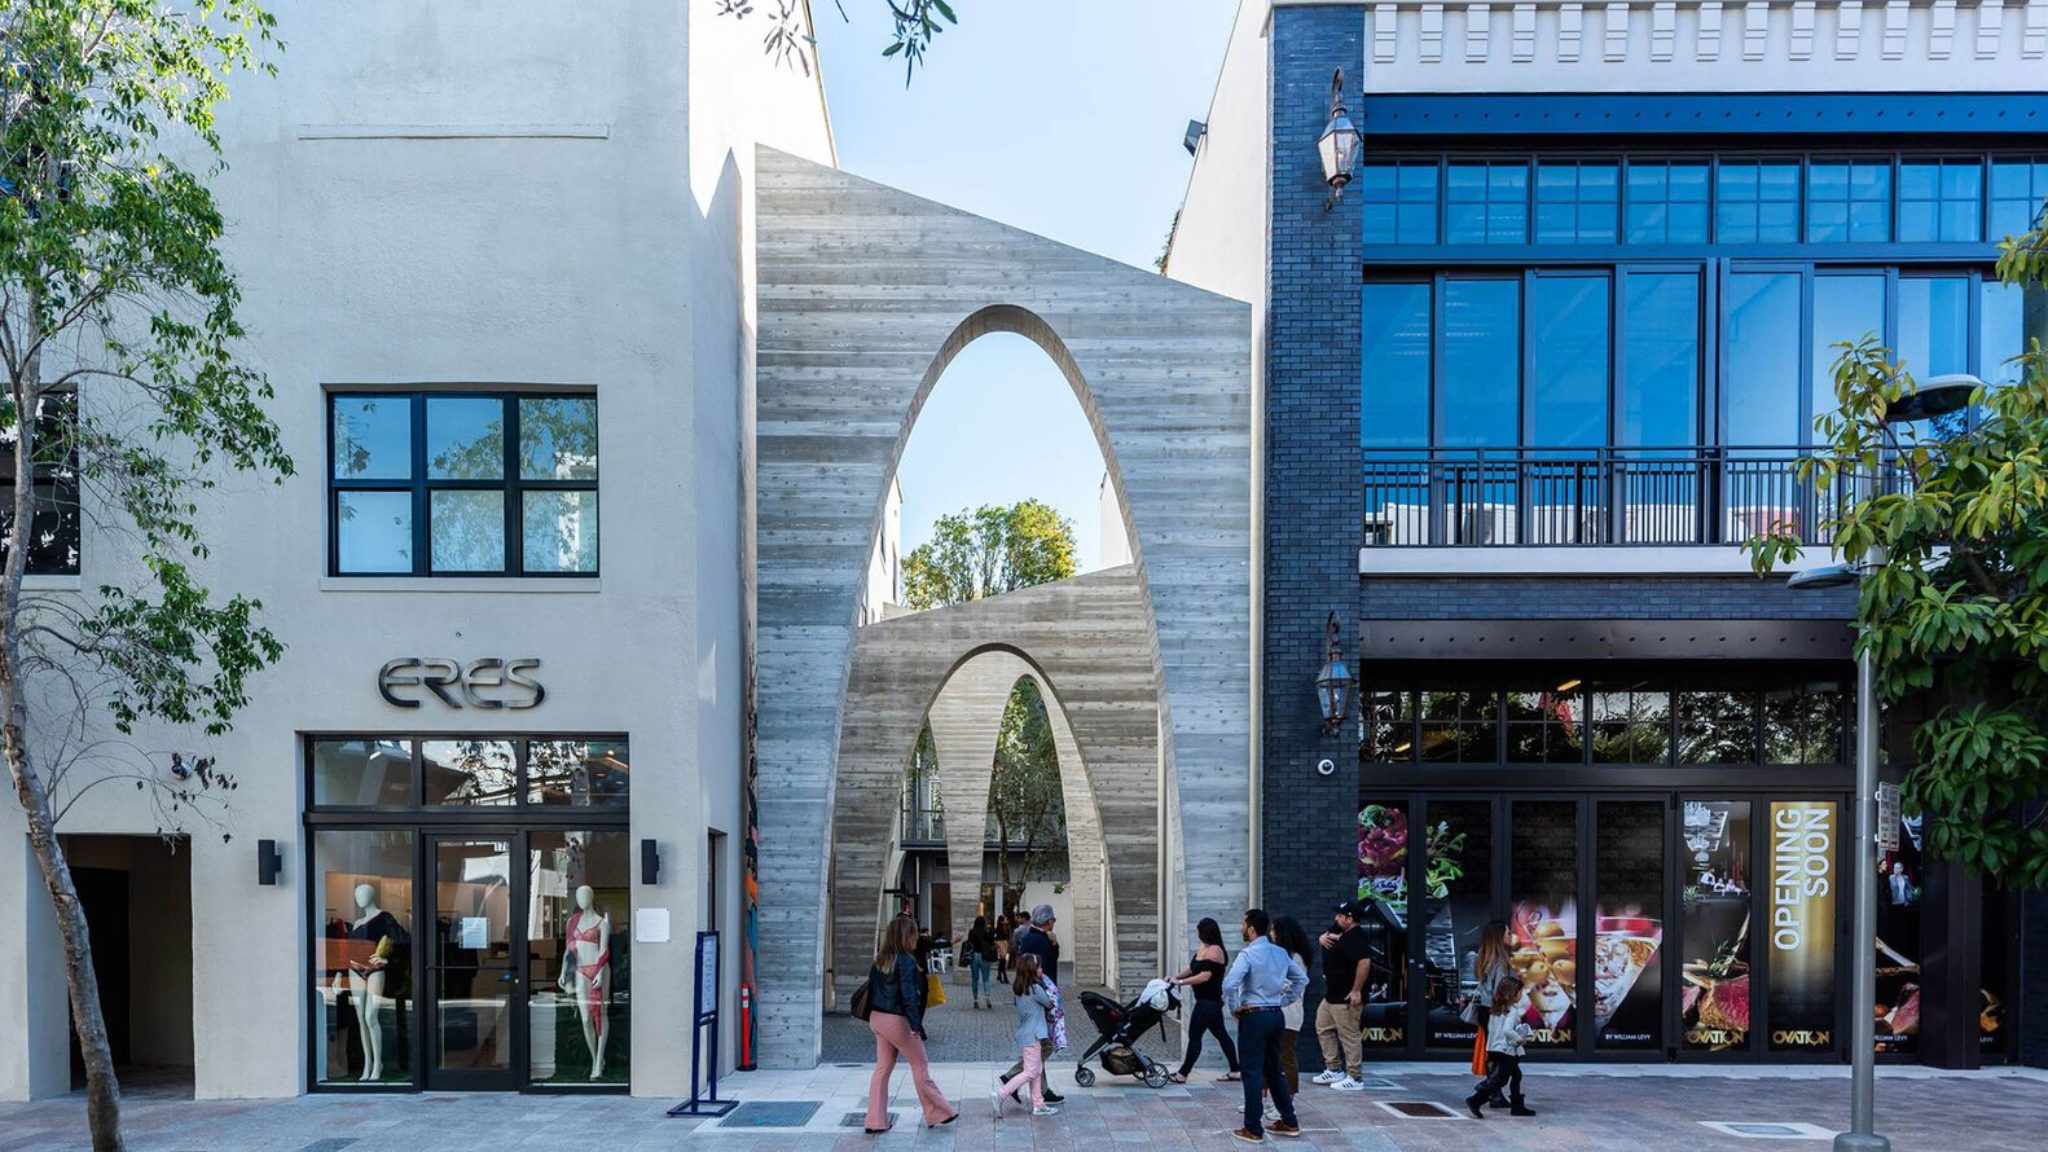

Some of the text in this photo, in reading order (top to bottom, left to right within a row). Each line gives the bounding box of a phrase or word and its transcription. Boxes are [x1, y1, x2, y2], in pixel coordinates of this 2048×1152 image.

[378, 657, 545, 709] ERES
[1804, 808, 1830, 897] SOON
[1775, 809, 1800, 950] OPENING
[1687, 1030, 1744, 1045] OVATION
[1772, 1030, 1830, 1046] OVATION
